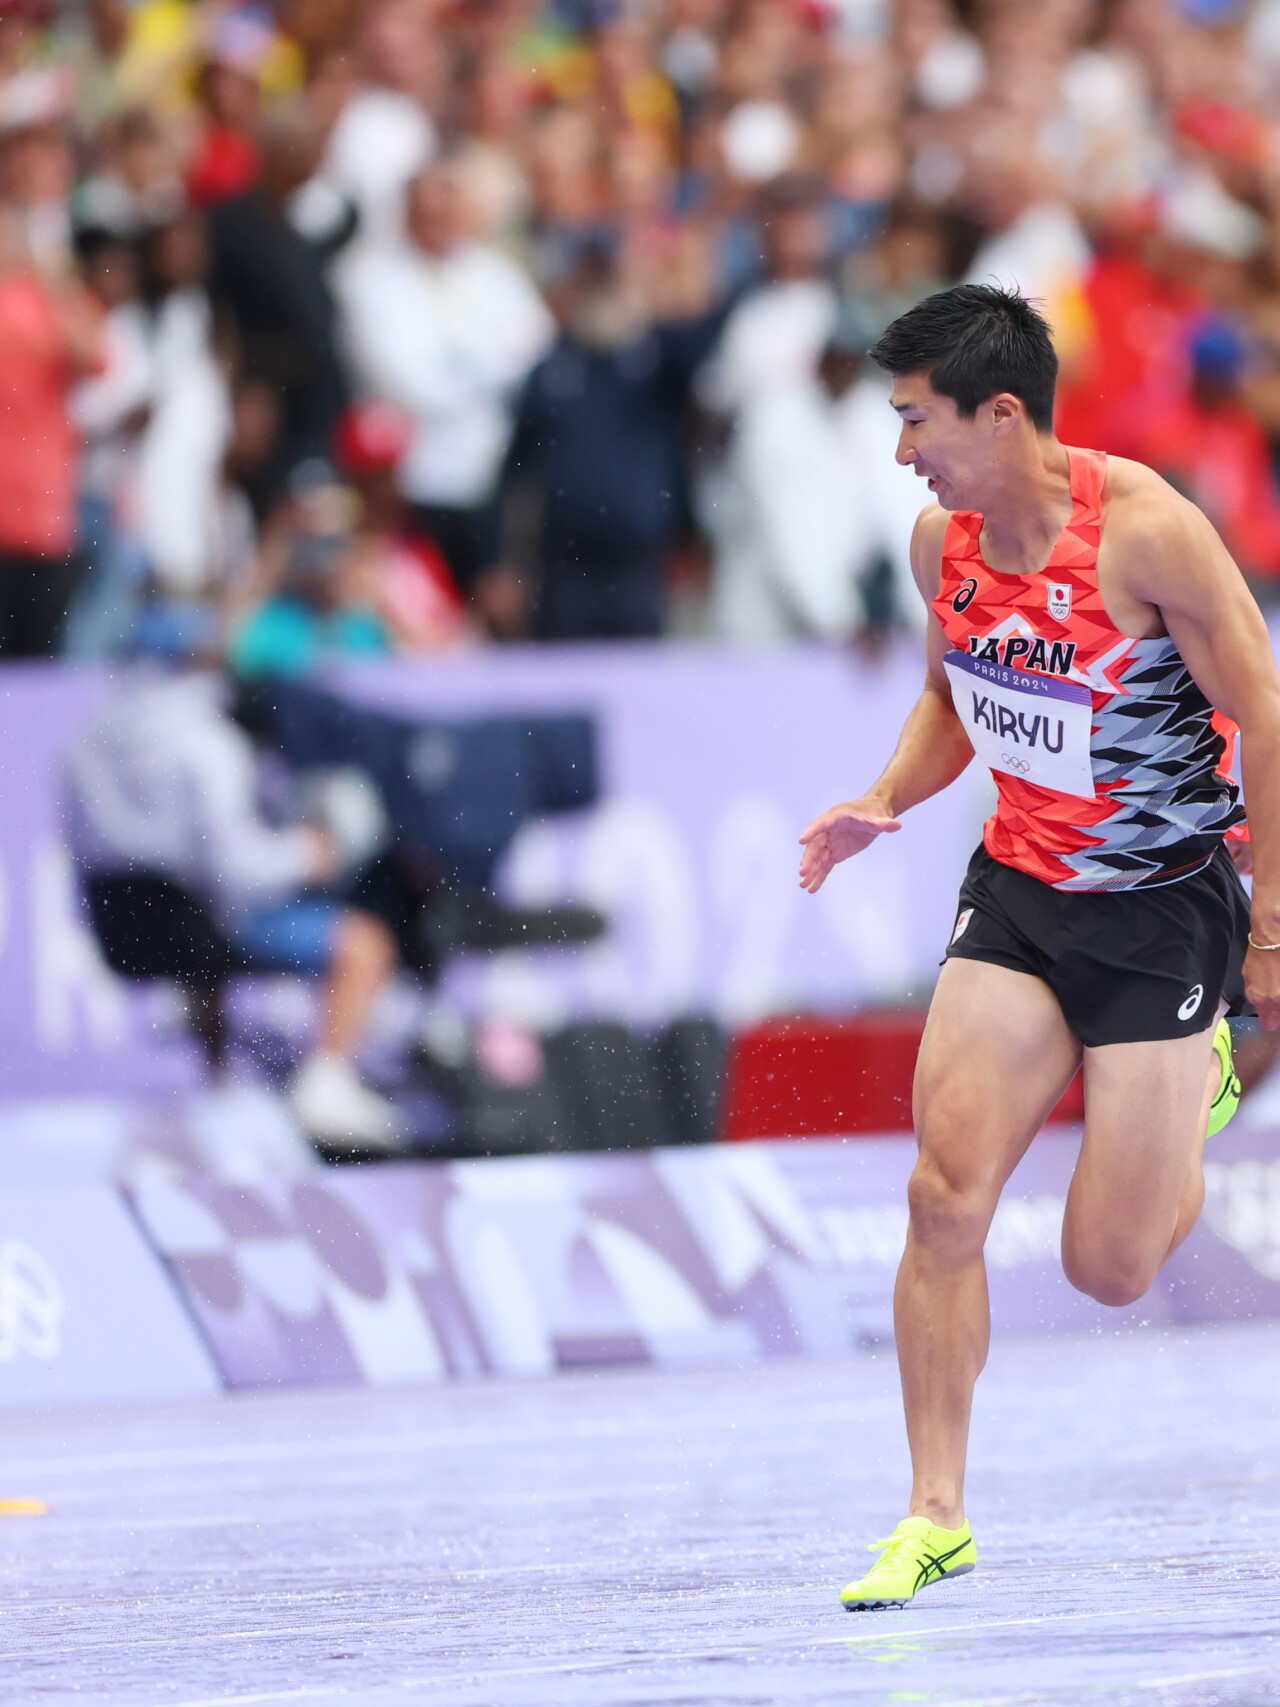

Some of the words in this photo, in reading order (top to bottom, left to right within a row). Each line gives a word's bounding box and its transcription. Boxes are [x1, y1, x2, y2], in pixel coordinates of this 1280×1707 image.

[974, 662, 1009, 682] PARIS
[1012, 675, 1048, 691] 2024
[971, 690, 1064, 754] KIRYU
